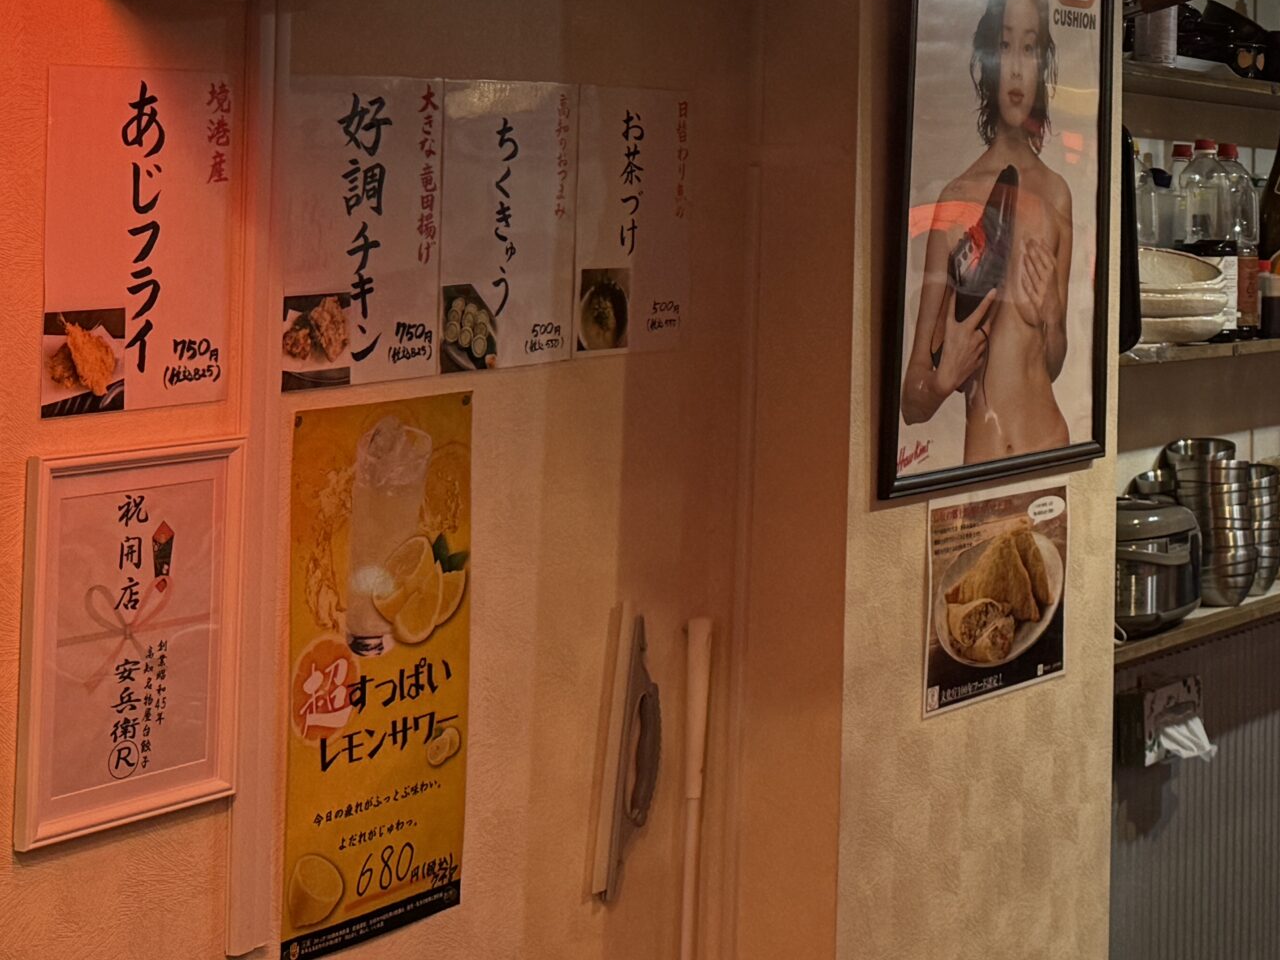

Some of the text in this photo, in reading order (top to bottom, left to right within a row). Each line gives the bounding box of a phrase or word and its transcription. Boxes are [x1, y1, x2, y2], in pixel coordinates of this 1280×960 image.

[1053, 8, 1097, 30] CUSHION
[206, 82, 231, 184] 境港産
[417, 84, 439, 265] 大きな竜田揚げ
[491, 117, 519, 318] ちくきゅう
[620, 109, 645, 257] お茶づけ
[121, 80, 166, 373] あじフライ
[337, 92, 393, 363] 好調チキン
[173, 338, 219, 364] 750円
[395, 321, 432, 343] 750円
[531, 322, 561, 337] 500円
[114, 494, 149, 611] 祝開店
[109, 658, 142, 744] 安兵衛
[154, 640, 168, 725] 創業昭和45年
[348, 657, 453, 715] すっぱい
[320, 711, 459, 773] レモンサワー
